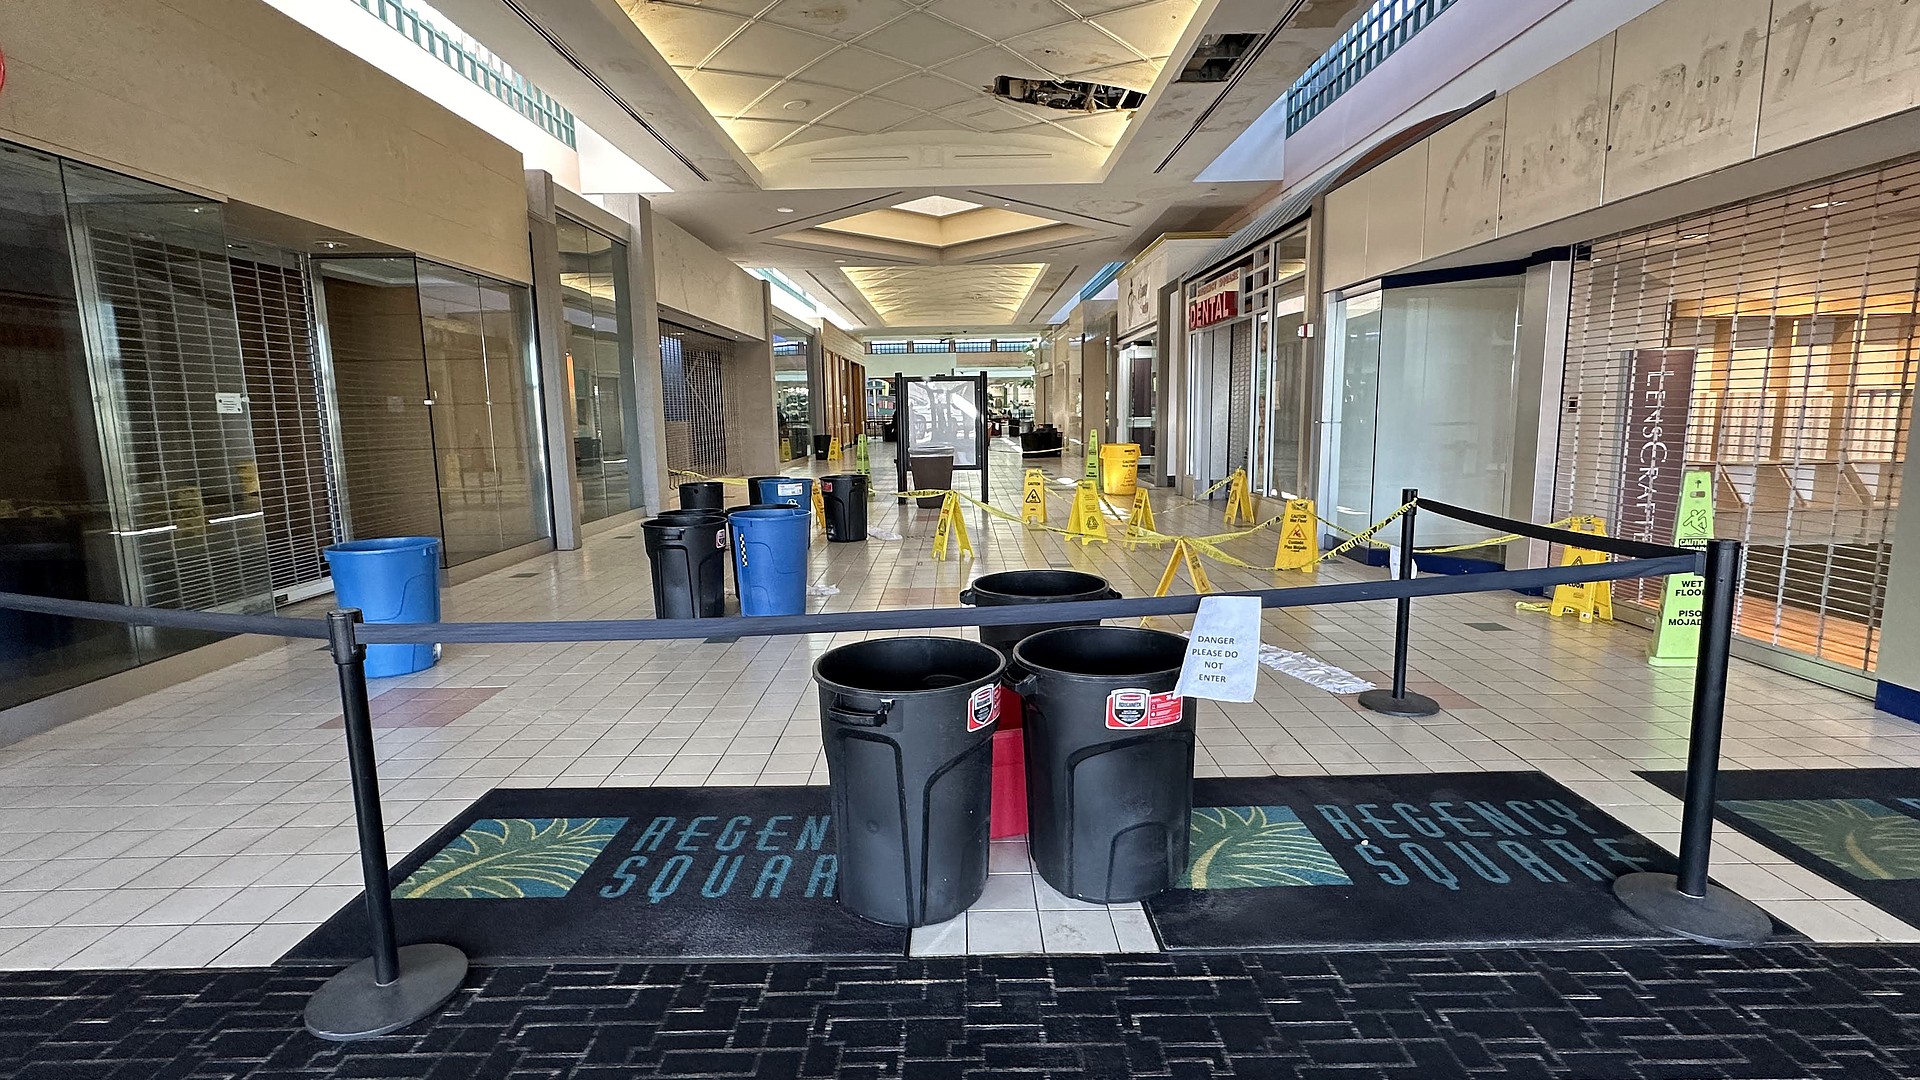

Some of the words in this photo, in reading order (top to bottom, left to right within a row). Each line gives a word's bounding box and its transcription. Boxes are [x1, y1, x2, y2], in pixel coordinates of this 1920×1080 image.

[1189, 292, 1229, 328] DENTAL
[1633, 370, 1675, 543] LENSCRAFTE
[1680, 539, 1708, 547] CAUTIO
[1681, 580, 1704, 588] WET
[1675, 589, 1705, 597] FLOO
[1678, 610, 1703, 618] PISO
[1668, 618, 1703, 626] MOJAD
[1197, 635, 1235, 645] DANGER
[1192, 648, 1223, 657] PLEASE
[1224, 650, 1239, 658] DO
[1204, 661, 1224, 670] NOT
[1198, 673, 1227, 683] ENTER
[1314, 799, 1600, 840] REGENCY
[631, 815, 831, 852] REGEN
[1354, 838, 1650, 891] SQUARE
[599, 853, 838, 904] SQUAR
